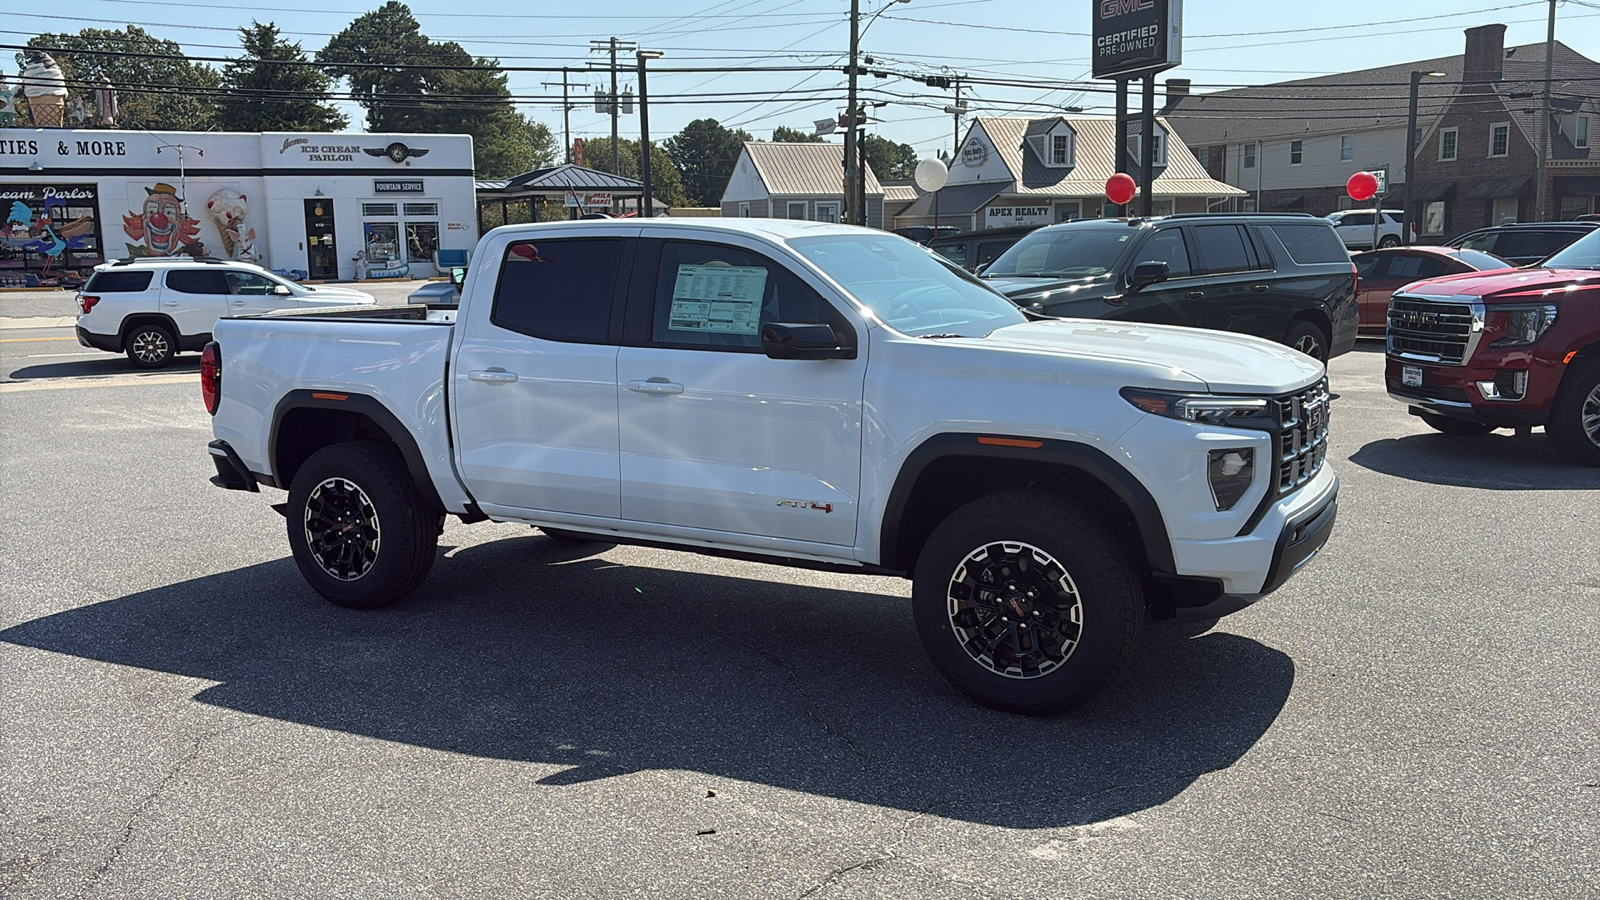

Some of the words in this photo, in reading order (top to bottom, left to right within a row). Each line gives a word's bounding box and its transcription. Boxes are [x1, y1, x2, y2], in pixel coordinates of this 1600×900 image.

[1097, 25, 1158, 47] CERTIFIED
[1100, 37, 1155, 57] PRE-OWNED
[58, 141, 69, 155] &
[76, 142, 126, 155] MORE
[42, 186, 95, 200] Parlor
[376, 183, 401, 191] FOUNTAIN
[402, 183, 422, 191] SERVICE
[989, 208, 1013, 216] APEX
[1015, 208, 1049, 216] REALTY
[1402, 310, 1438, 324] GMC
[776, 498, 834, 514] AT4
